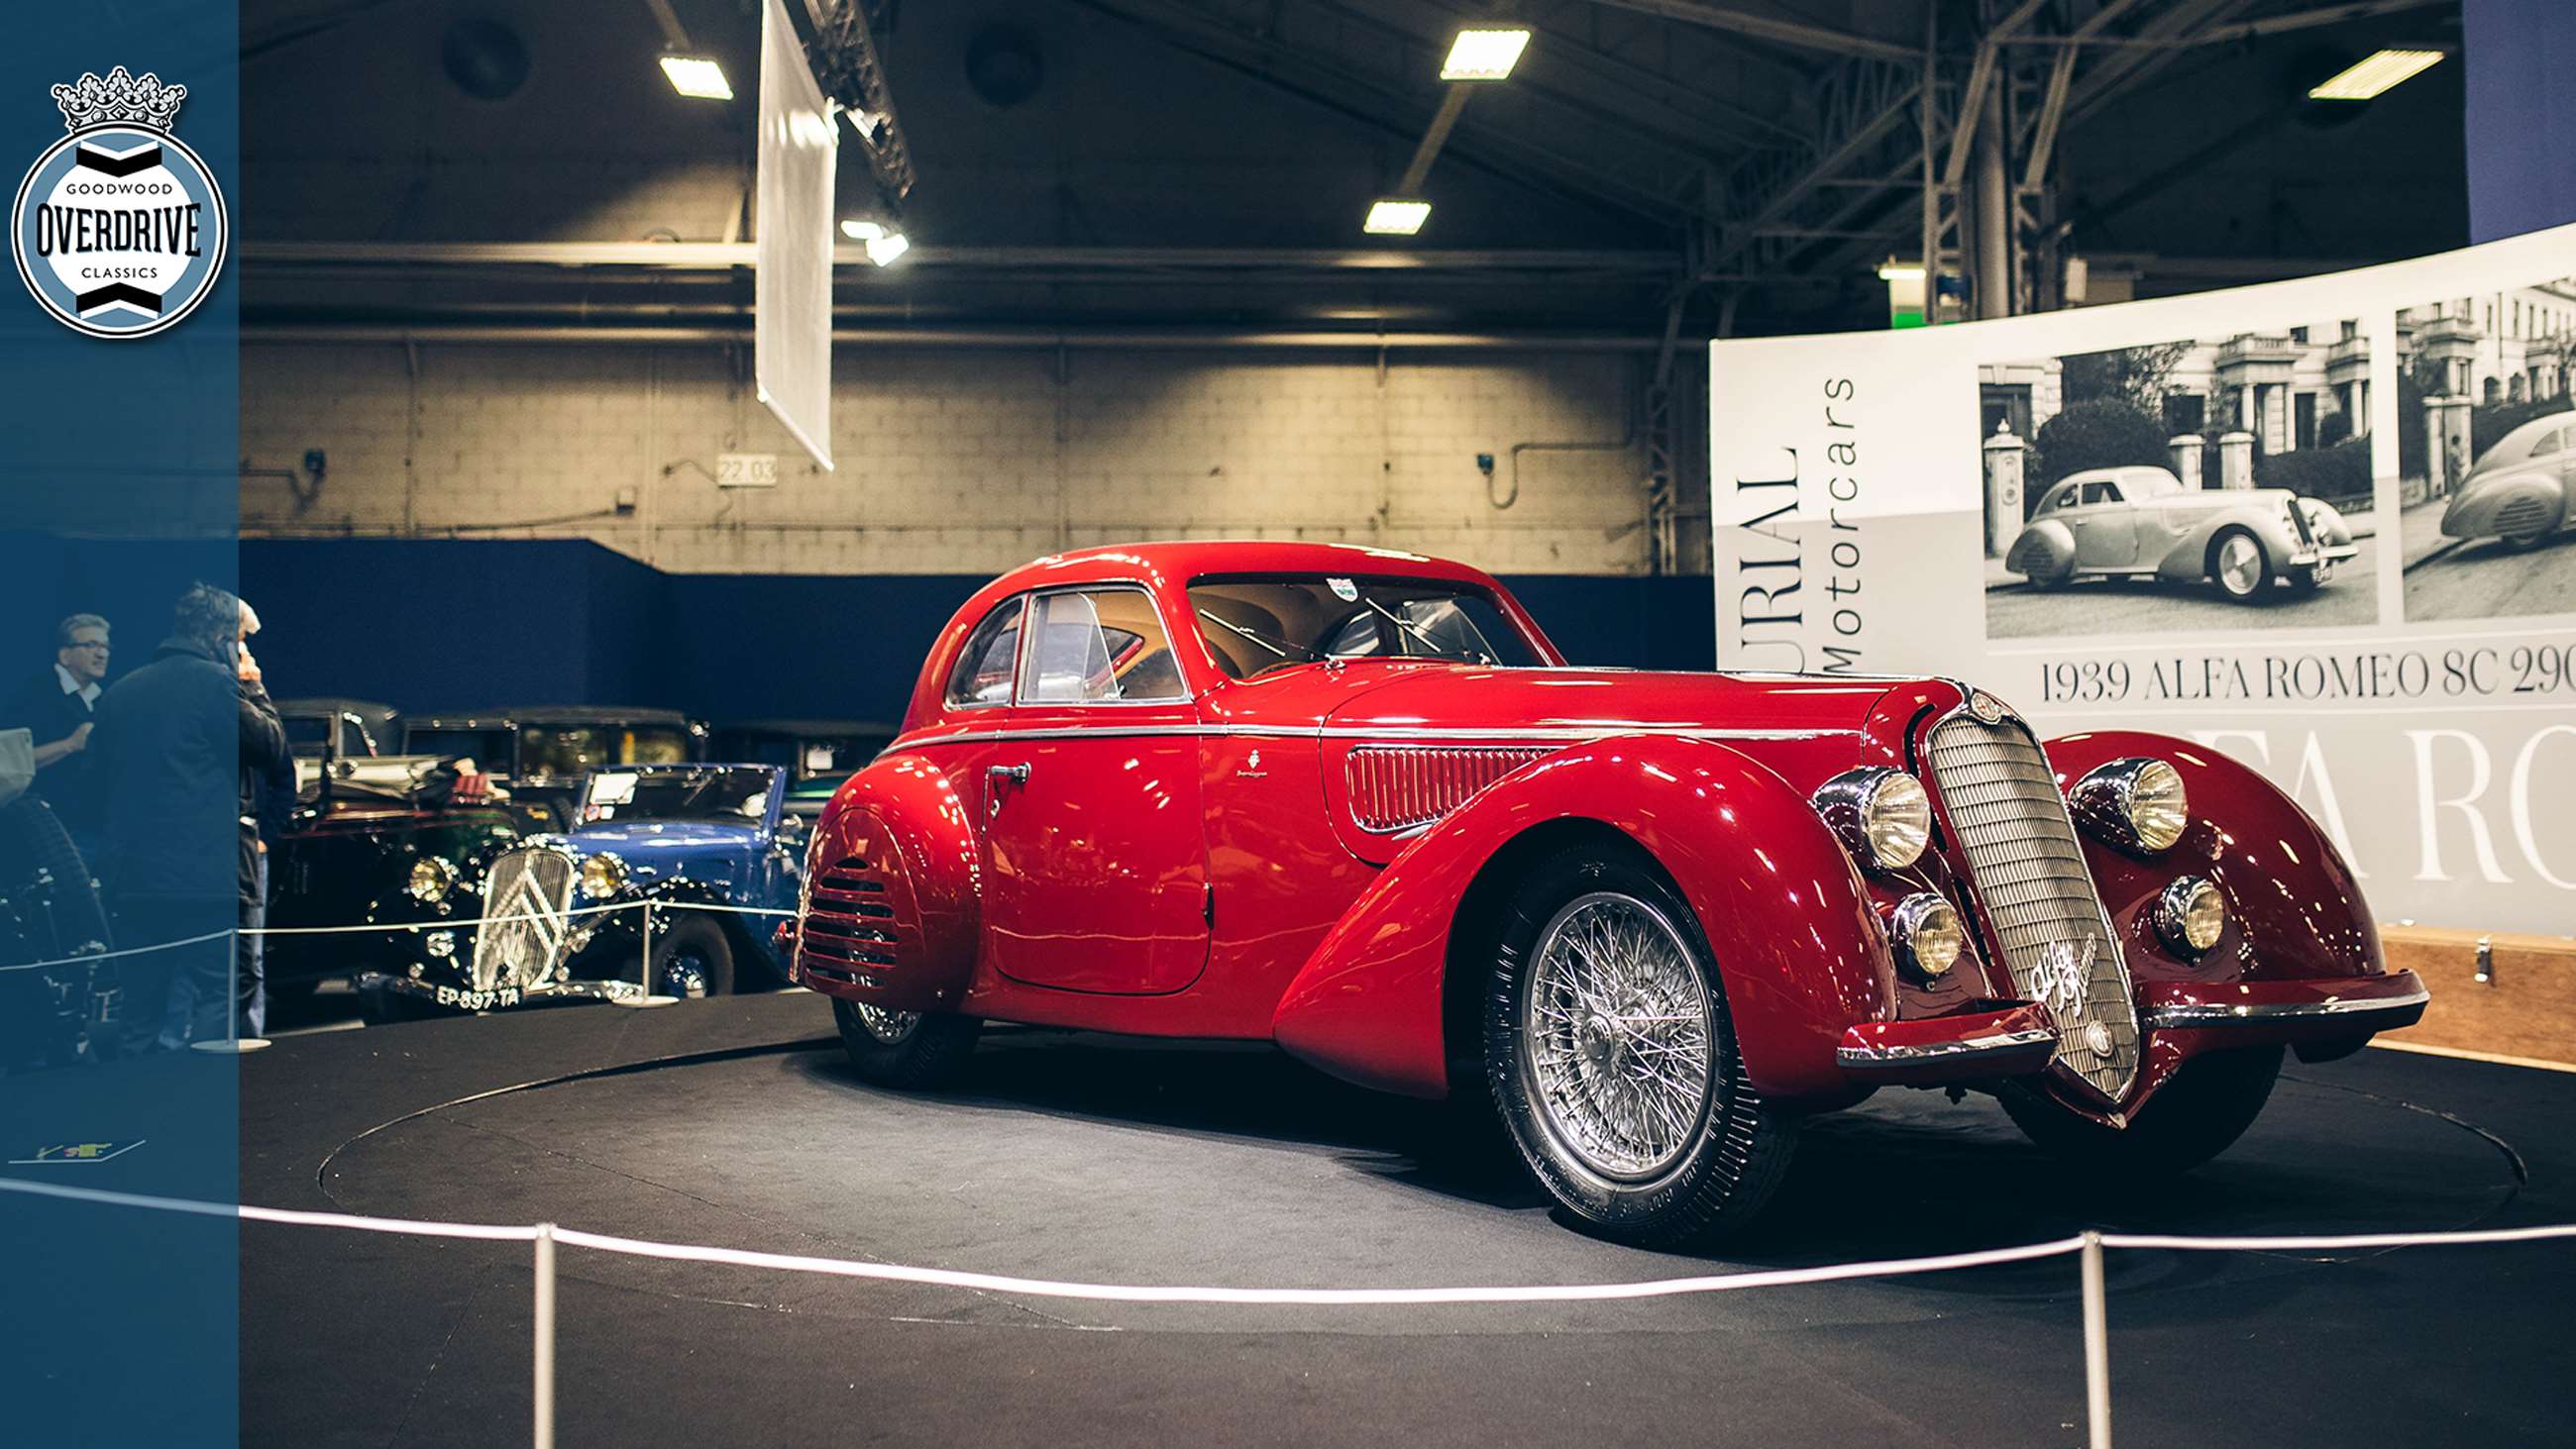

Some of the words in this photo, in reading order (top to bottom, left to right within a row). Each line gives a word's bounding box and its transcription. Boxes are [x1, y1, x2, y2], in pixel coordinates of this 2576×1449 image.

[1822, 378, 1863, 674] Motorcars
[2043, 659, 2131, 703] 1939
[2144, 656, 2251, 700] ALFA
[2264, 650, 2430, 700] ROMEO
[2442, 647, 2500, 696] 8C
[2401, 724, 2576, 890] RO
